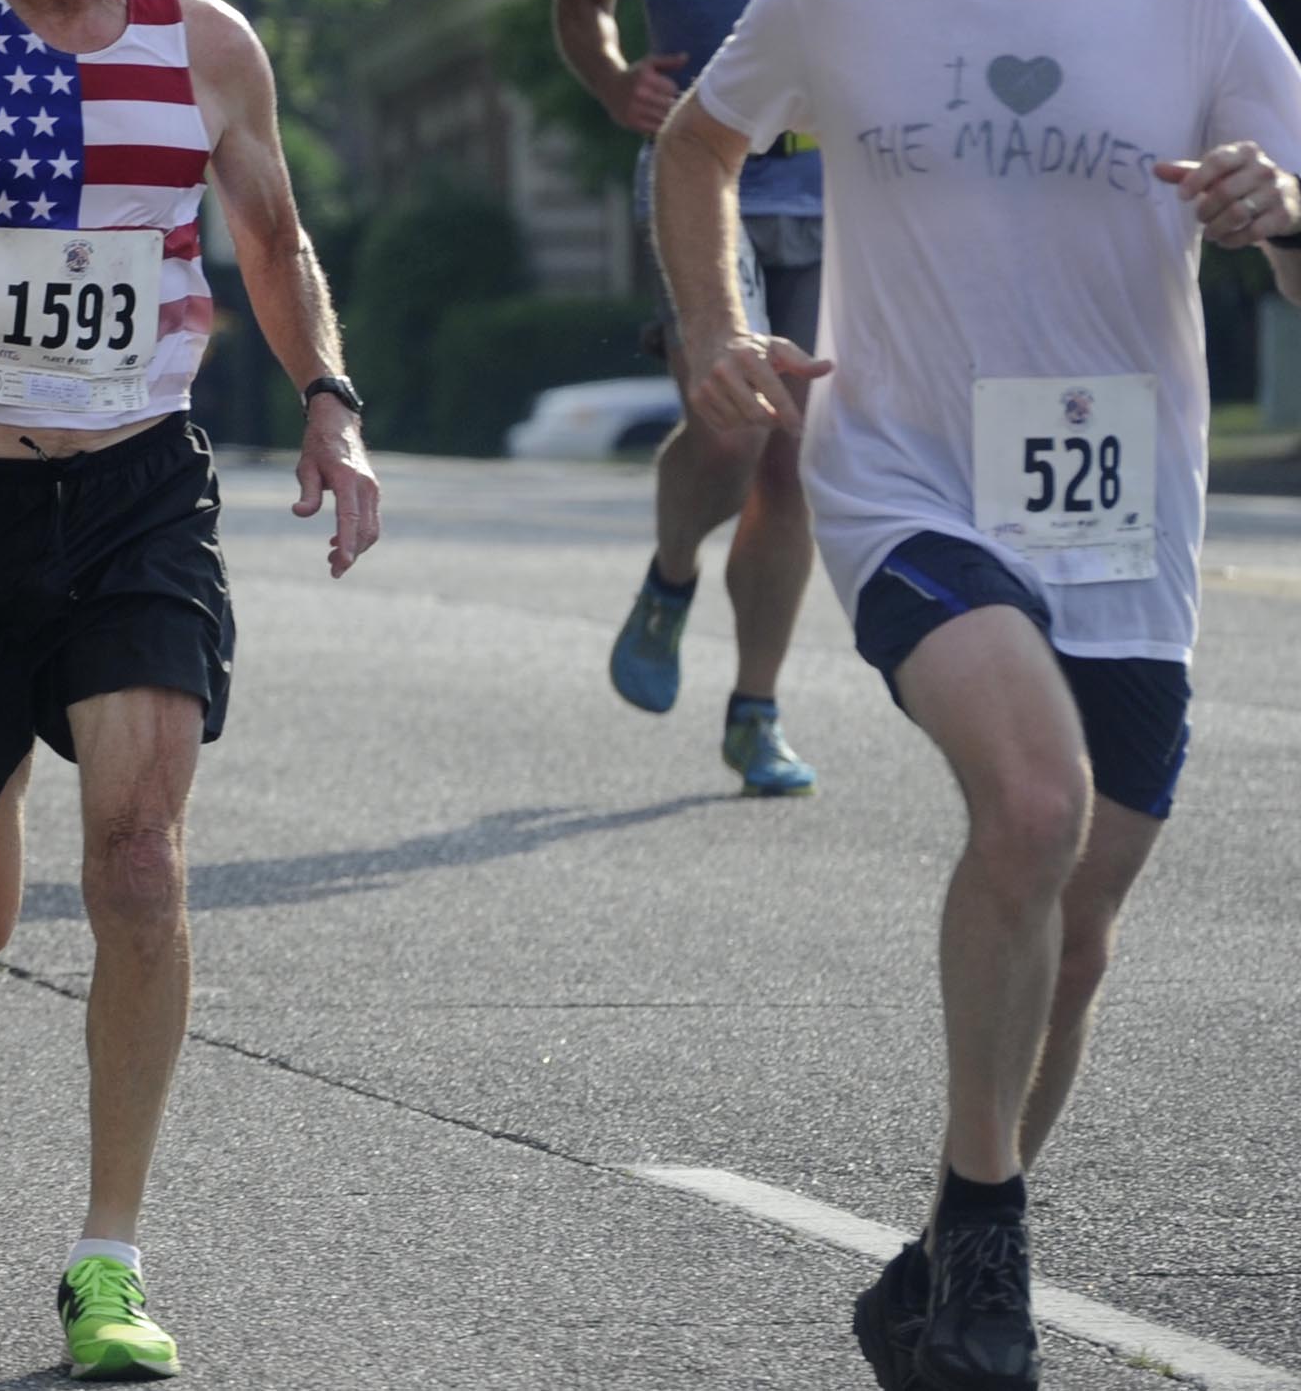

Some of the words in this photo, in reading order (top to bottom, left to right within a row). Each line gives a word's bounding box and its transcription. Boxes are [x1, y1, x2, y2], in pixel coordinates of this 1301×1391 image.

[943, 56, 968, 110] I
[857, 122, 933, 182] THE
[953, 118, 1161, 202] MADNES
[3, 281, 136, 351] 1593
[1024, 435, 1121, 513] 528
